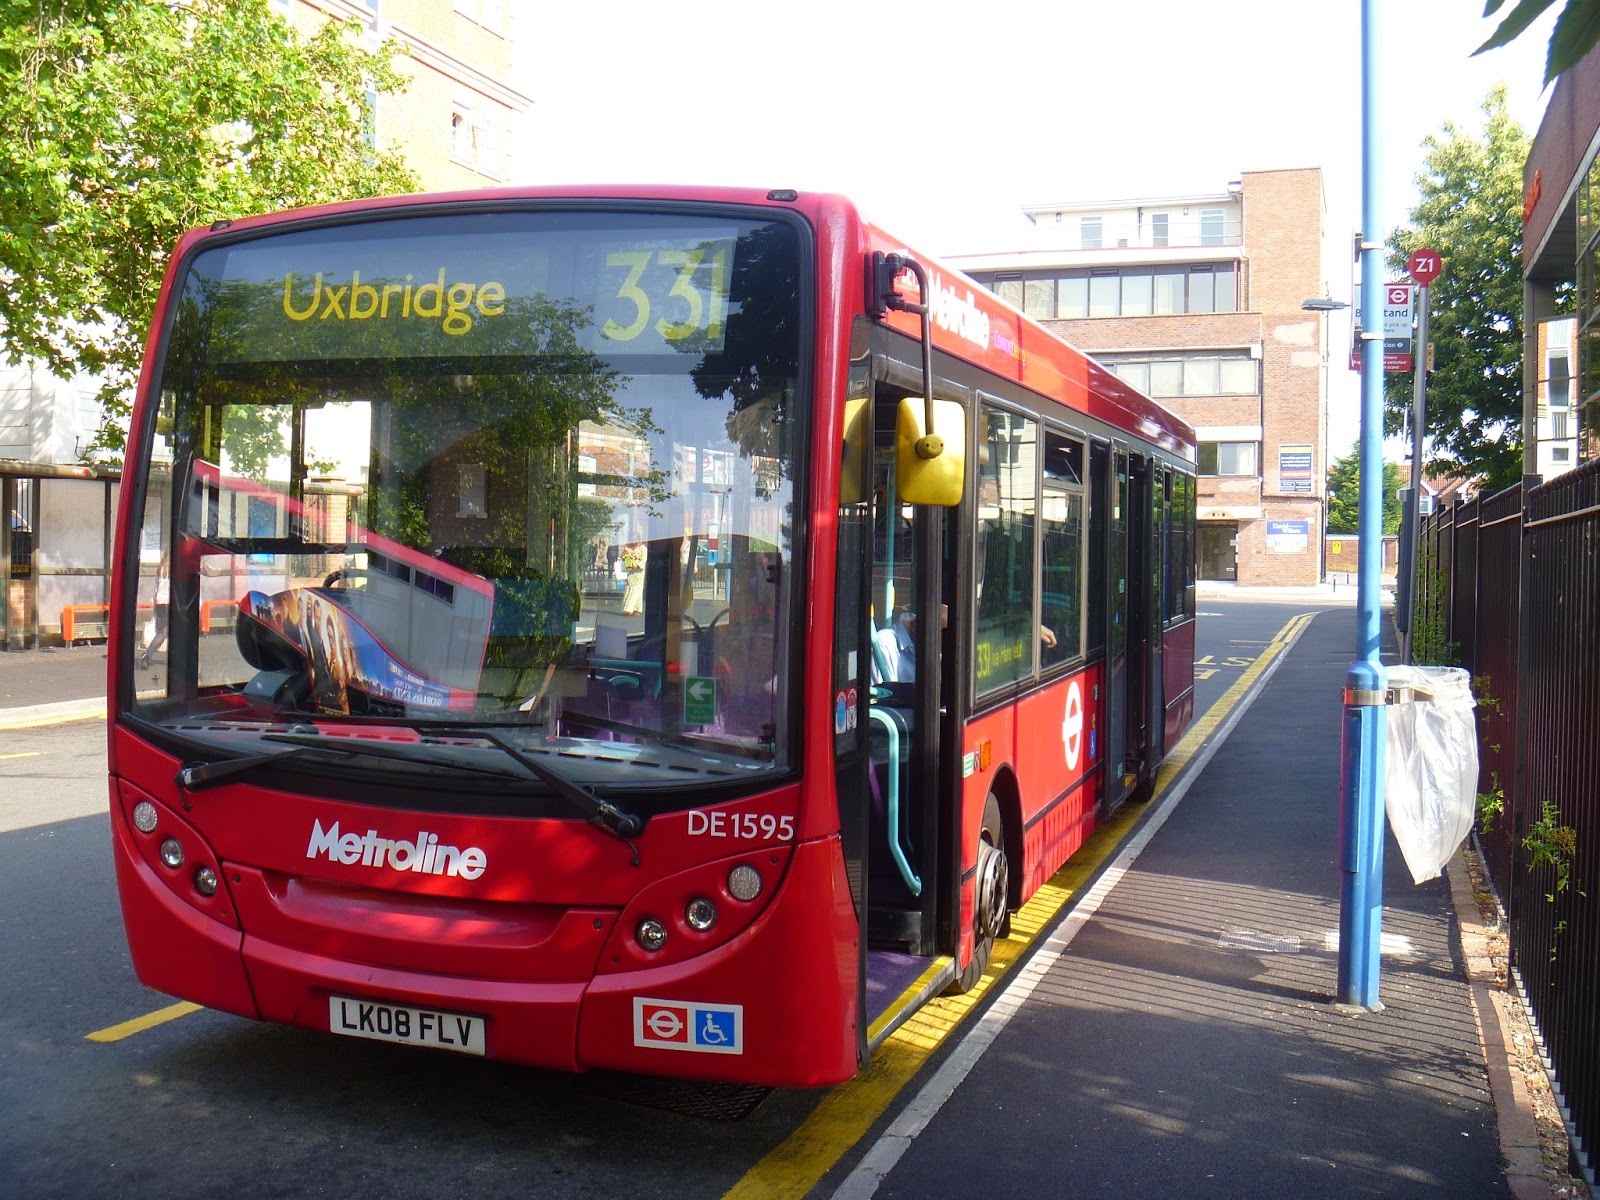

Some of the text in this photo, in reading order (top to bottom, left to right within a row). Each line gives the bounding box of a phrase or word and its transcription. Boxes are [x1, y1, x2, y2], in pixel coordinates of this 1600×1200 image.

[1415, 257, 1434, 273] Z1
[283, 247, 726, 341] Uxbridge 331
[928, 267, 990, 350] Metroline
[1384, 308, 1408, 318] tand
[688, 810, 795, 841] DE 1595
[307, 818, 488, 881] Metroline
[341, 1001, 472, 1047] LK08 FLV
